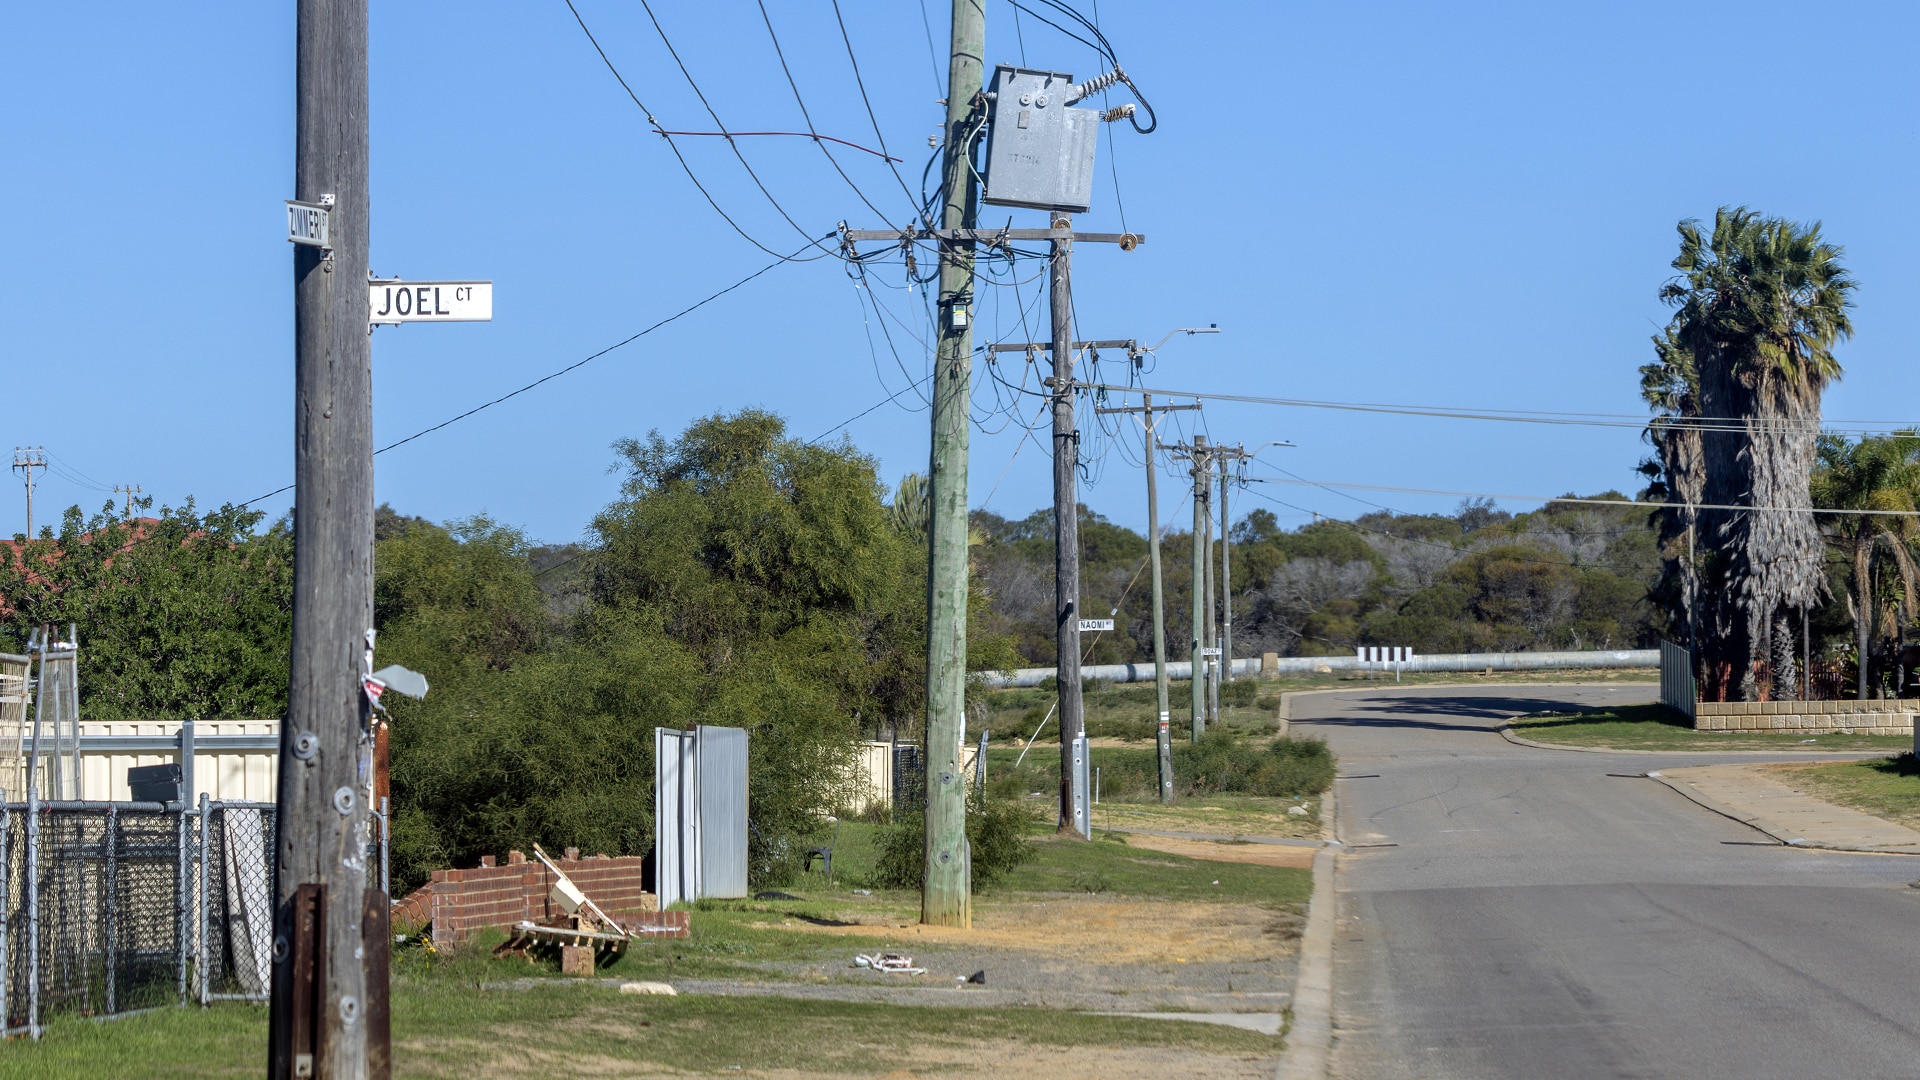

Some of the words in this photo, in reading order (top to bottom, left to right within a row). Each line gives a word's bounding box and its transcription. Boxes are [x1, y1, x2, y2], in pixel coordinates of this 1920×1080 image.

[377, 287, 450, 316] JOEL
[456, 287, 473, 301] CT
[1080, 620, 1105, 629] NAOMI
